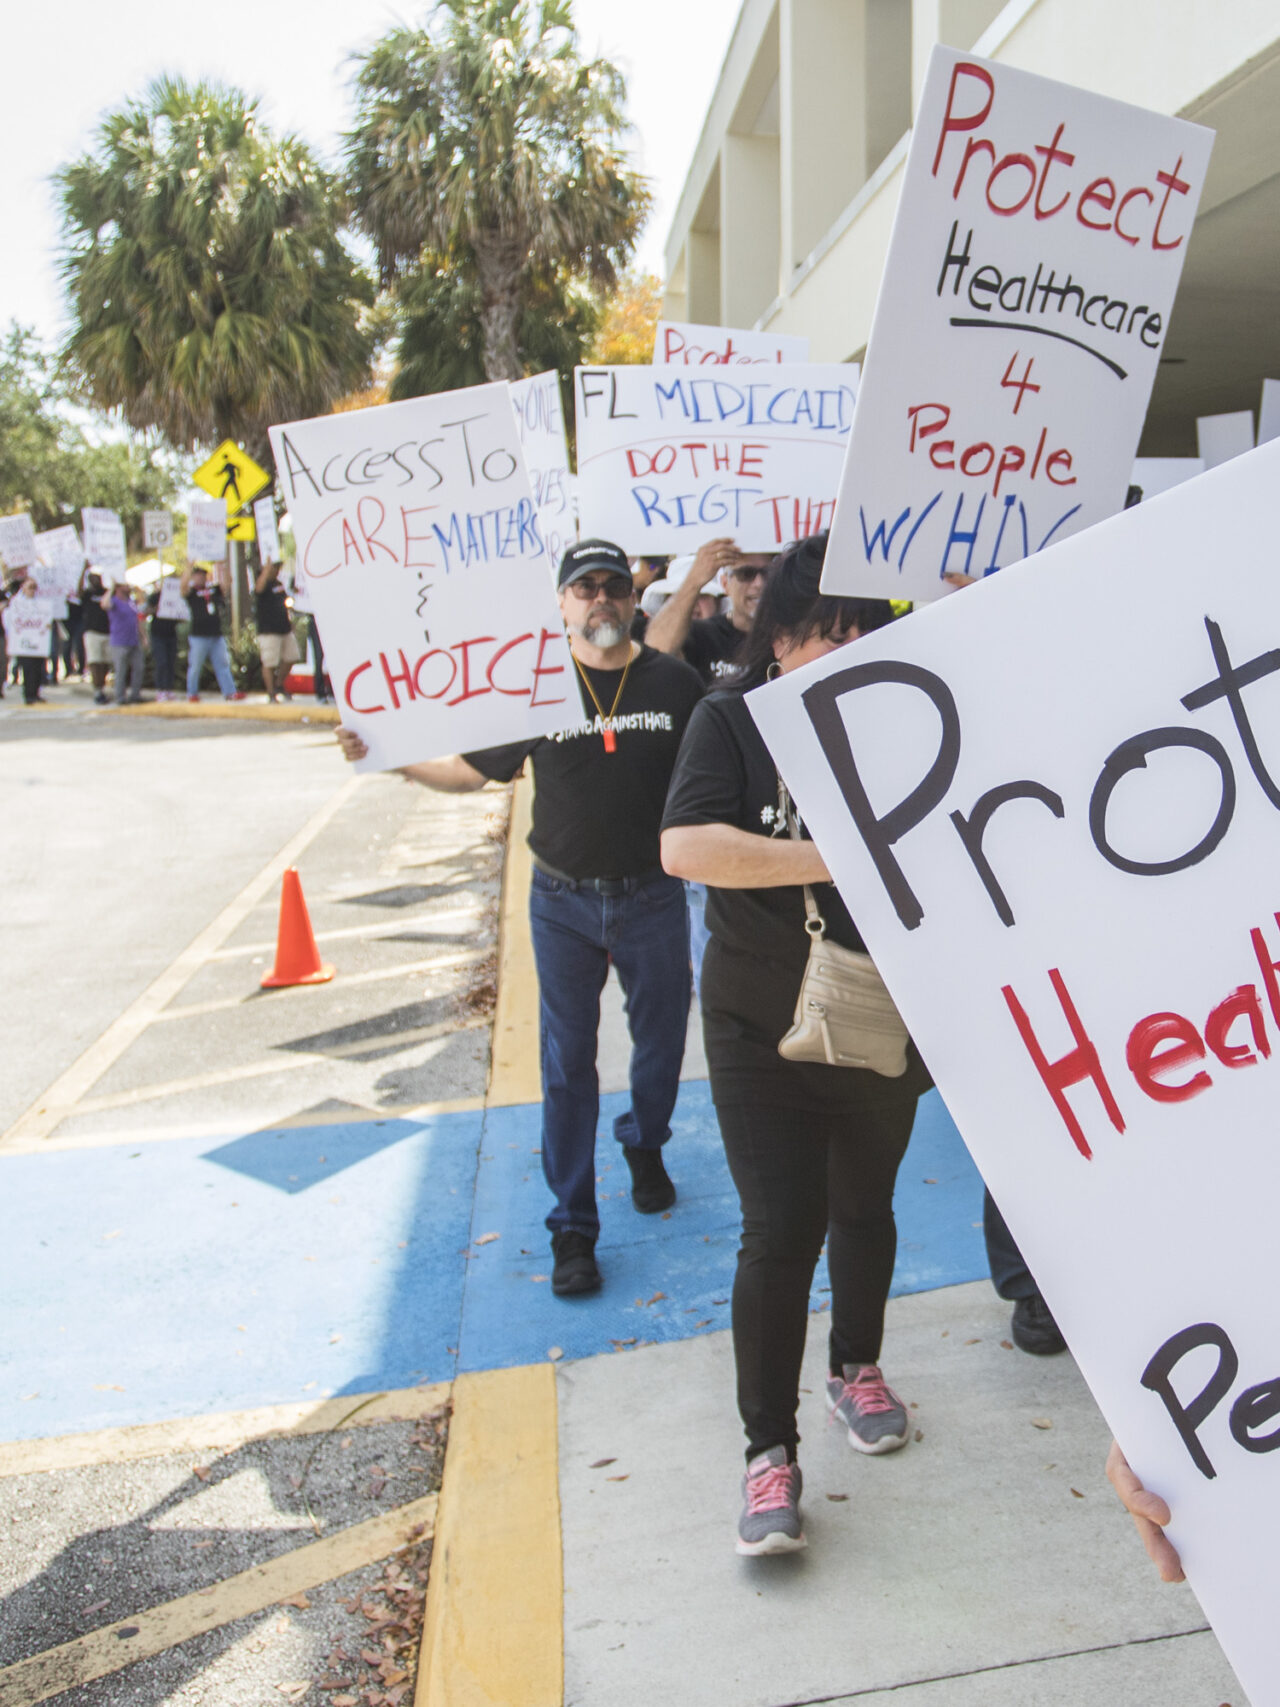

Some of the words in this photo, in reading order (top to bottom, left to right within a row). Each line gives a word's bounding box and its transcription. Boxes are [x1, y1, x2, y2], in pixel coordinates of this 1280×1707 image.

[932, 62, 1191, 251] Protect
[937, 220, 1163, 348] Healthcare
[664, 328, 782, 364] Prot
[1000, 351, 1041, 415] 4
[580, 371, 639, 419] FL
[654, 378, 858, 434] MEDICAID
[907, 402, 1078, 499] People
[304, 495, 440, 578] CARE
[431, 497, 545, 574] MATTERS
[631, 484, 763, 528] RIGT
[754, 496, 837, 544] THI
[344, 628, 567, 715] CHOICE
